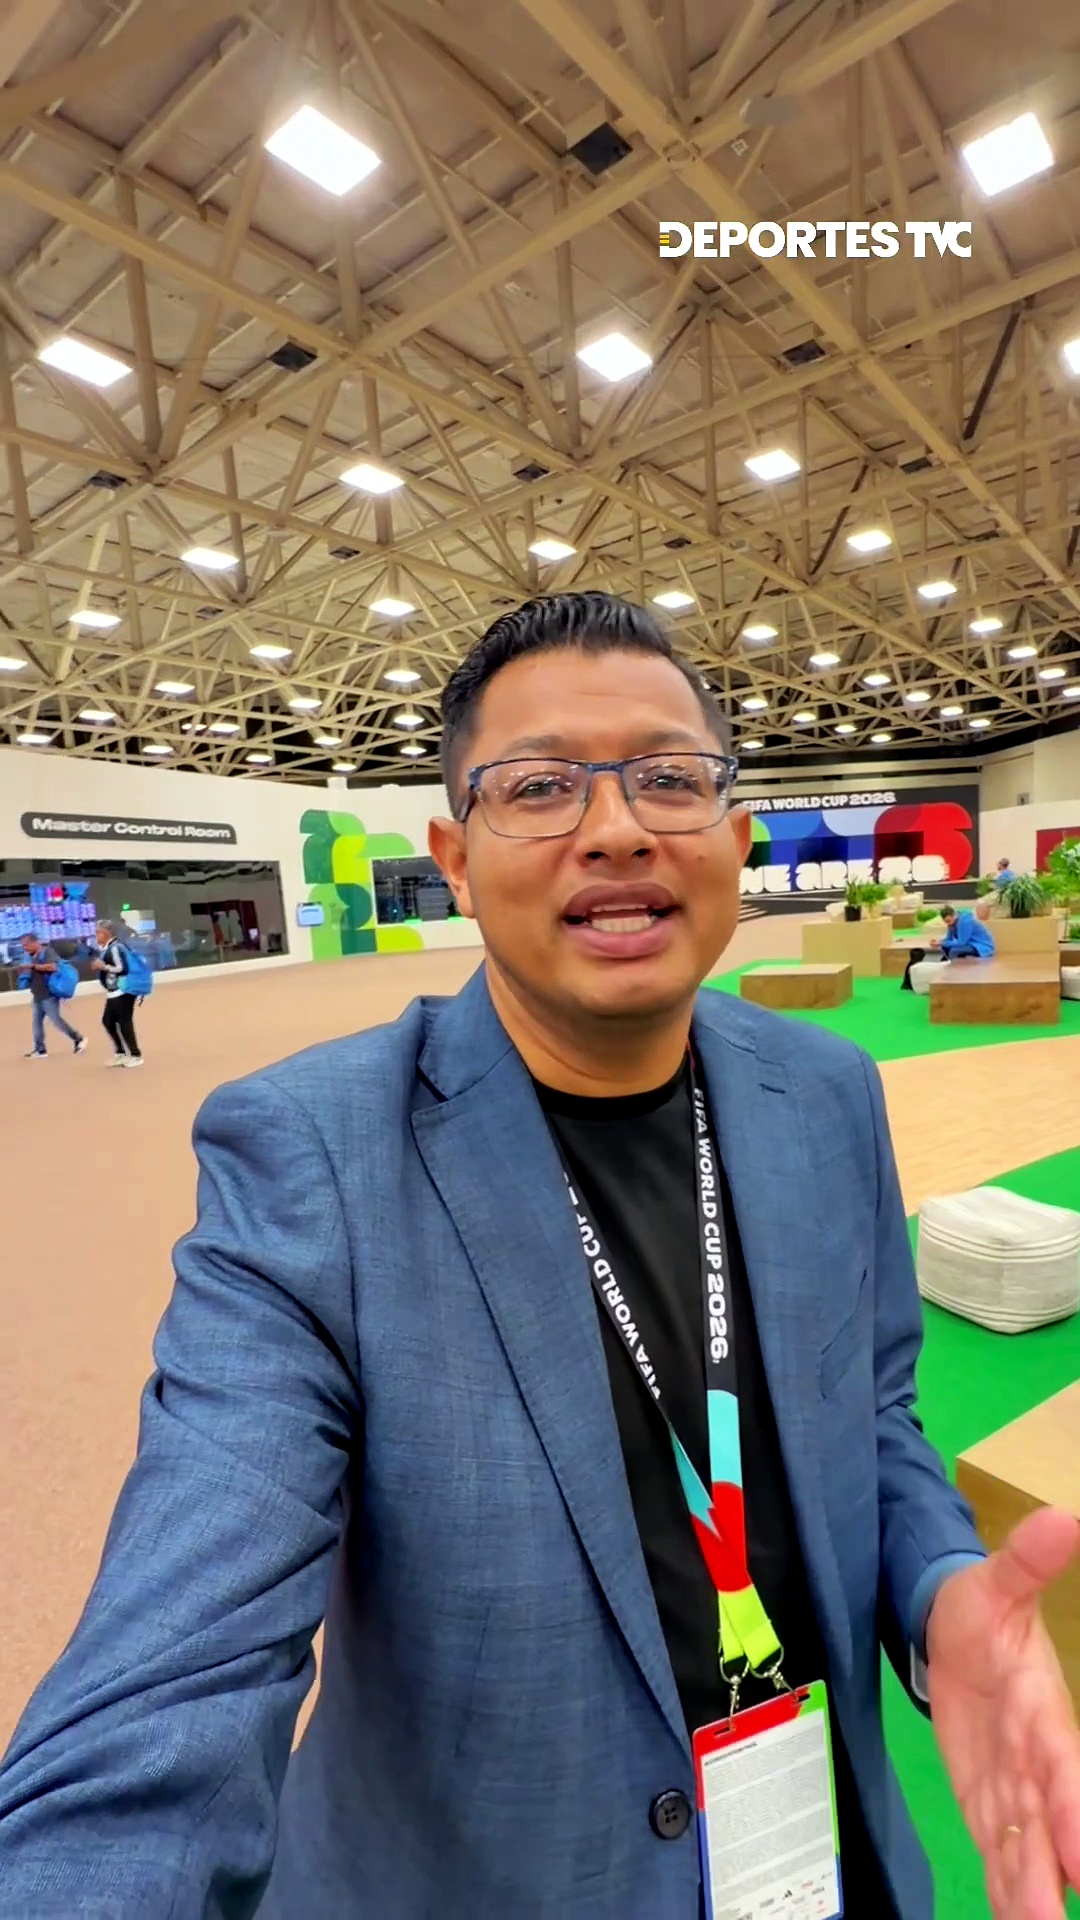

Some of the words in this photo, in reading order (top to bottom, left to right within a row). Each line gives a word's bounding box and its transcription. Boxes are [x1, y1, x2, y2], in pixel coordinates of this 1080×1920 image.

[772, 796, 821, 810] WORLD
[822, 794, 848, 807] CUP
[849, 792, 897, 805] 2026
[32, 818, 112, 833] Master
[114, 822, 183, 837] Control
[184, 826, 231, 838] Room
[694, 1088, 708, 1133] FIFA
[699, 1138, 718, 1219] WORLD
[704, 1222, 723, 1270] CUP
[593, 1259, 639, 1347] WORLD
[707, 1273, 729, 1359] 2026
